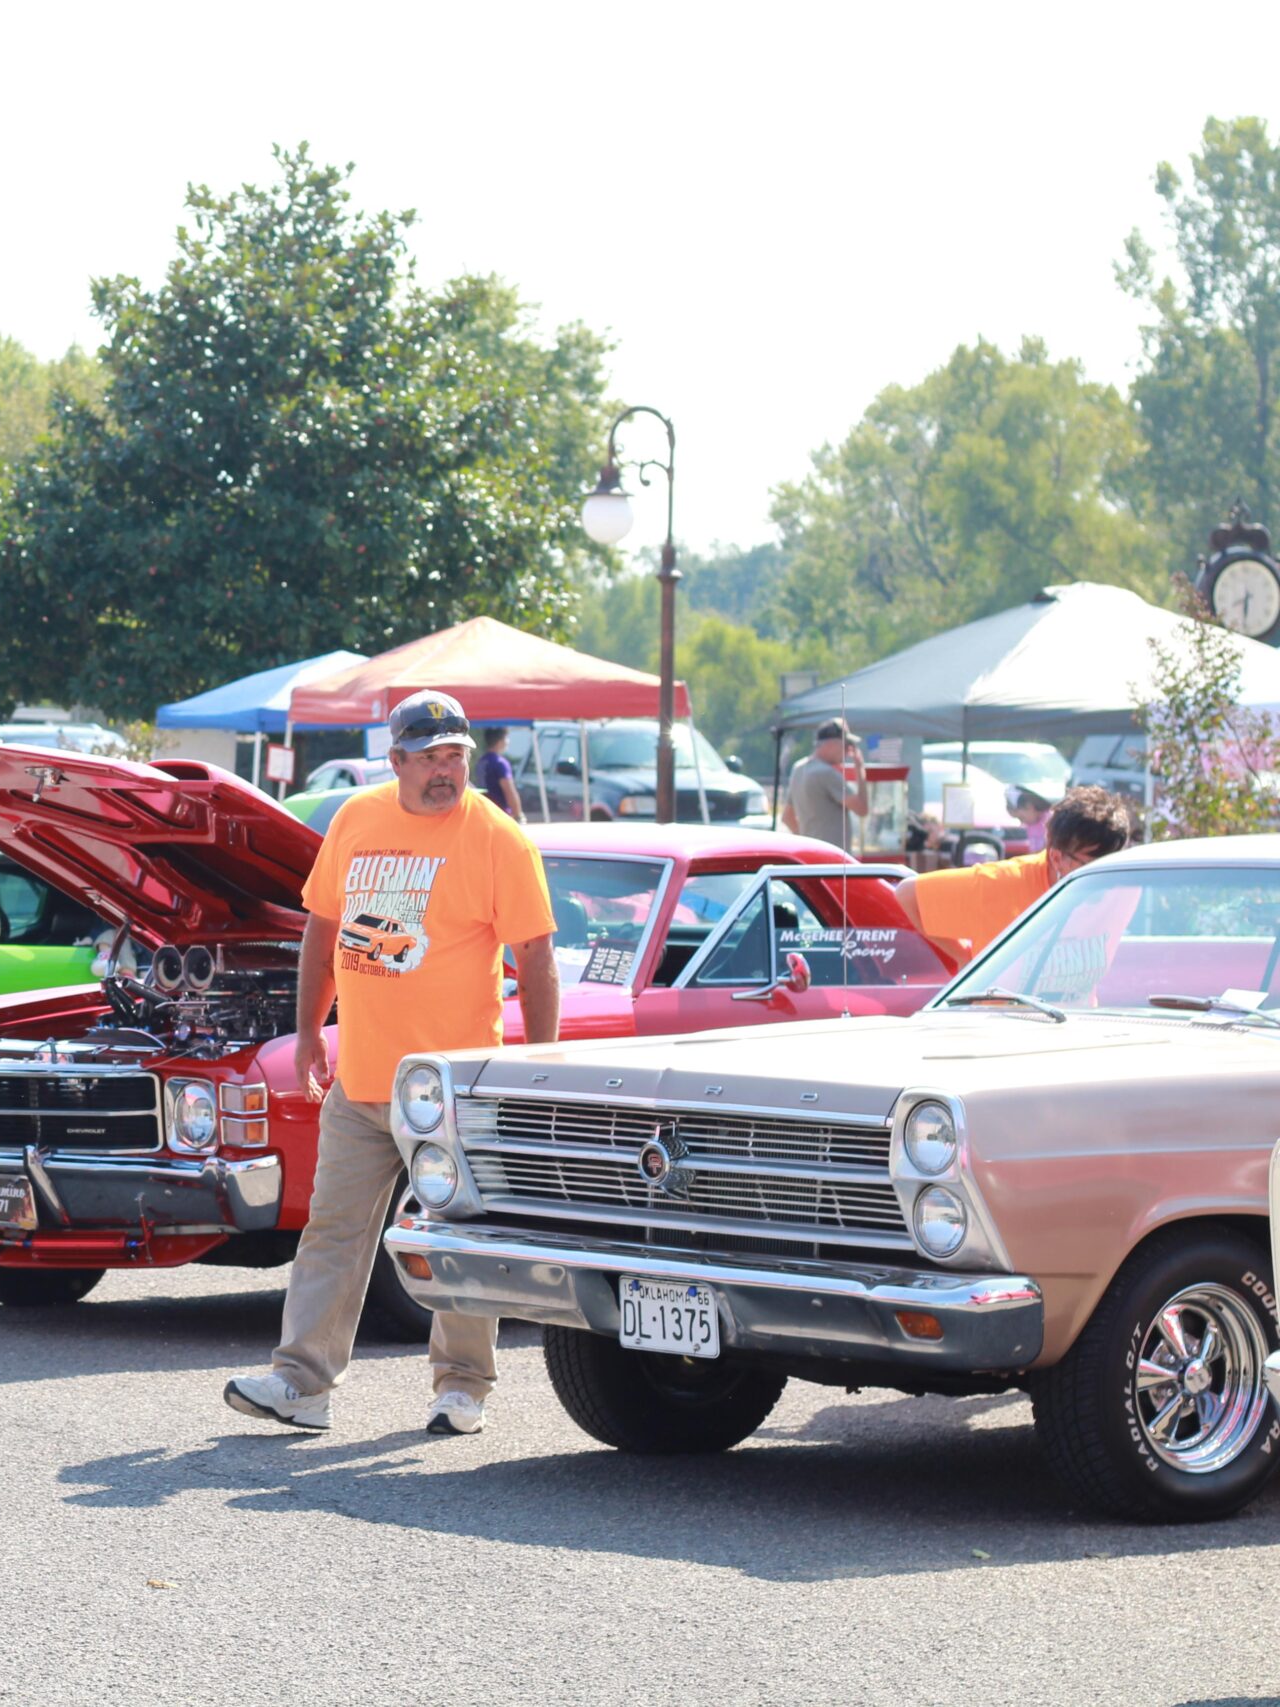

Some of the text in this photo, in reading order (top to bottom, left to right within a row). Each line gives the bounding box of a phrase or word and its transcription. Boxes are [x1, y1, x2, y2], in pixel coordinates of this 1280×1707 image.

[345, 856, 447, 893] BURNIN'
[396, 892, 430, 912] MAIN
[340, 951, 401, 979] 2019 OCTOBER 5TH
[587, 947, 609, 980] PLEASE
[600, 948, 622, 982] DO NOT
[840, 940, 896, 963] Racing
[531, 1073, 820, 1102] FORD
[640, 1286, 692, 1304] OKLAHOMA
[697, 1291, 710, 1306] 66
[1124, 1378, 1159, 1472] RADIAL
